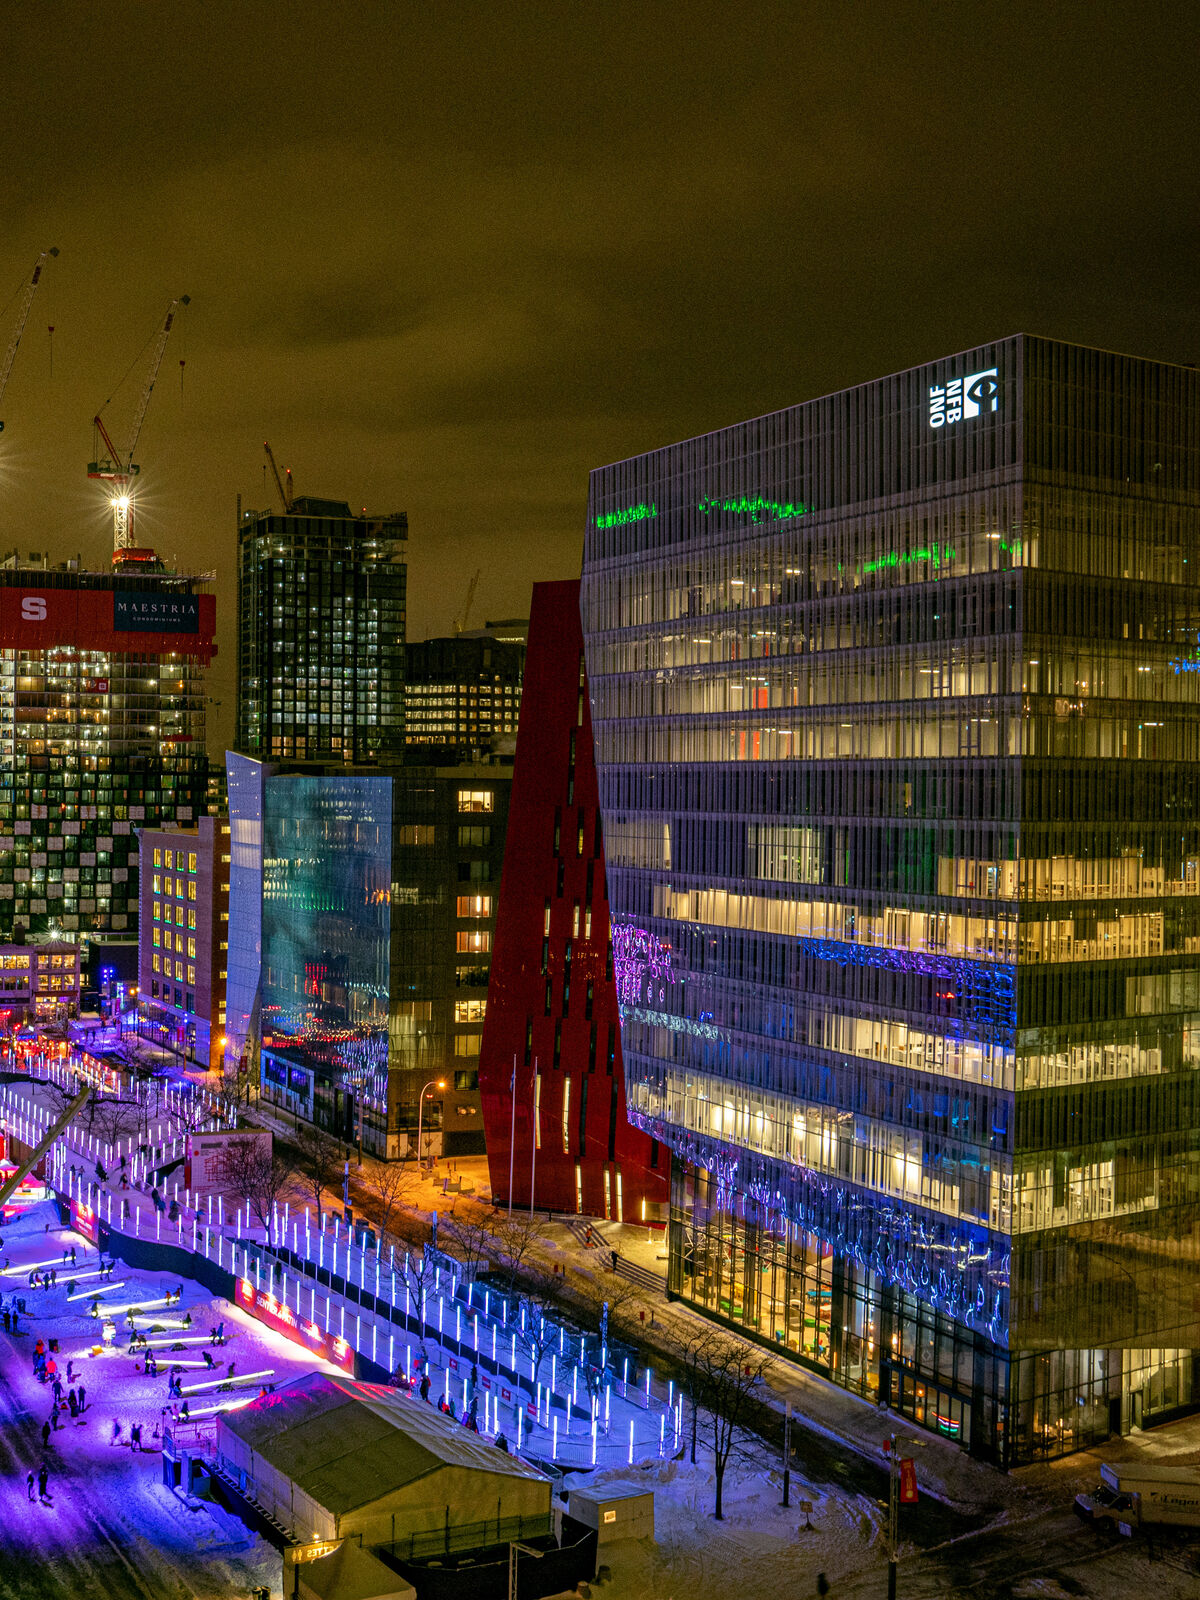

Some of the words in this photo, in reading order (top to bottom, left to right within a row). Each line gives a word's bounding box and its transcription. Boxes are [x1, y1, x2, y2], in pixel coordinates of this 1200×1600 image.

[929, 385, 946, 428] ONF
[946, 378, 962, 424] NFB
[21, 597, 47, 621] S
[117, 602, 196, 614] MAESTRIA
